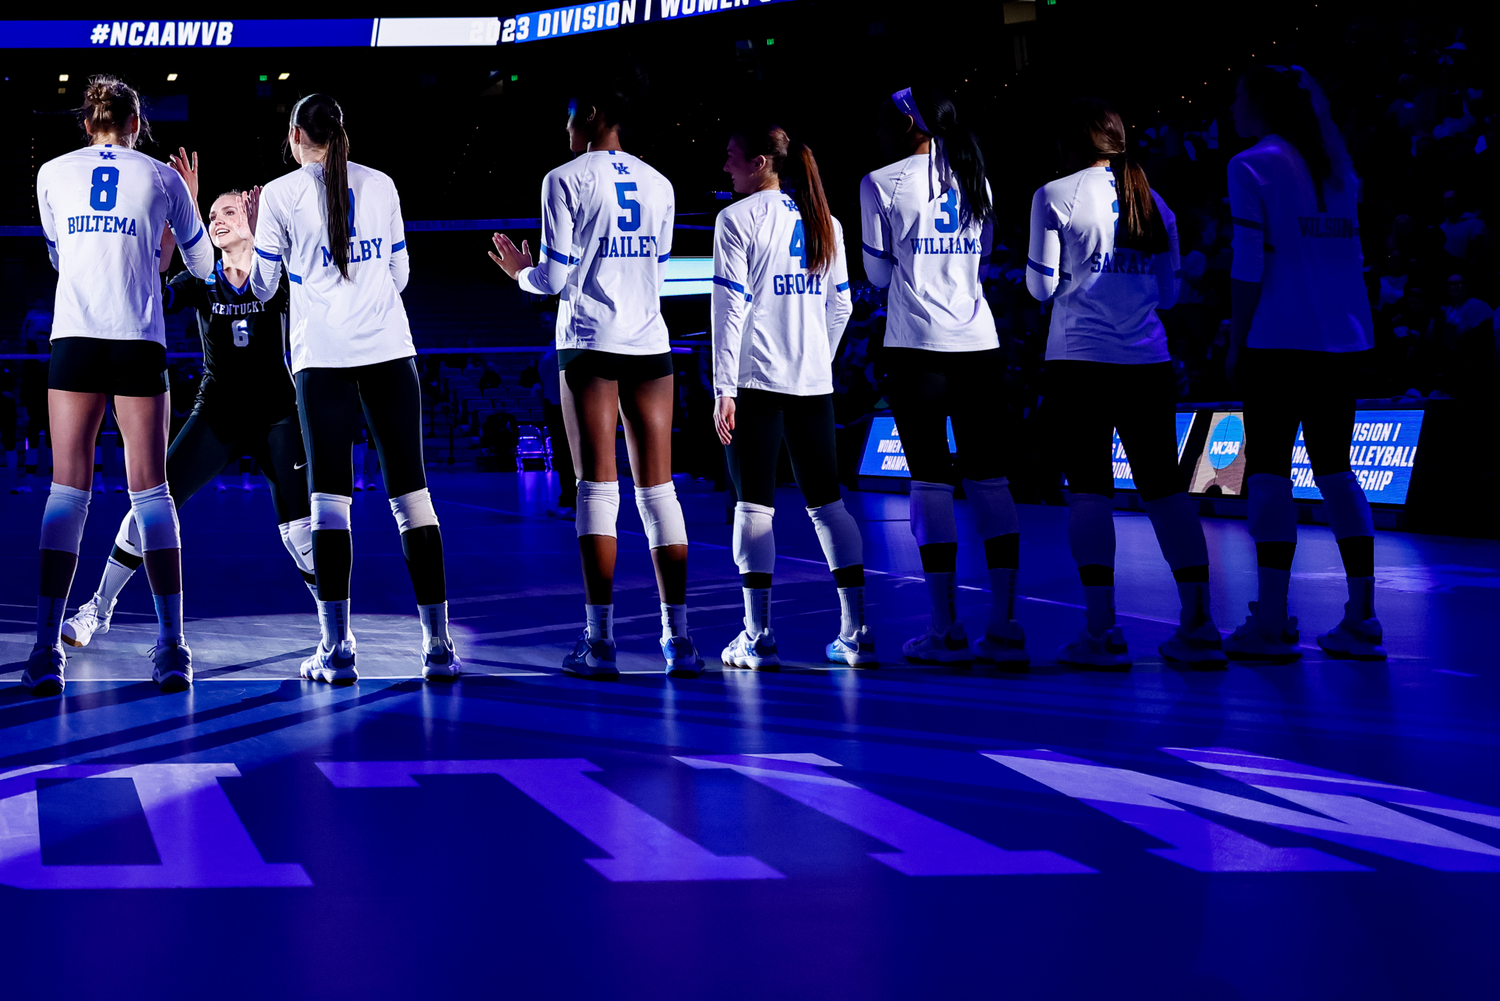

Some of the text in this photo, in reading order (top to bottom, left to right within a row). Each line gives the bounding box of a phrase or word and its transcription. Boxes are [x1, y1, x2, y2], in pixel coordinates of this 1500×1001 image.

[536, 0, 636, 37] DIVISION
[90, 21, 233, 46] #NCAAWVB
[90, 166, 119, 211] 8
[614, 182, 641, 232] 5
[935, 186, 959, 233] 3
[68, 215, 137, 236] BULTEMA
[321, 238, 382, 267] MLBY
[599, 236, 658, 258] DAILEY
[789, 219, 809, 269] 4
[212, 301, 266, 315] KENTUCKY
[232, 319, 249, 347] 6
[1210, 441, 1240, 455] NCAA
